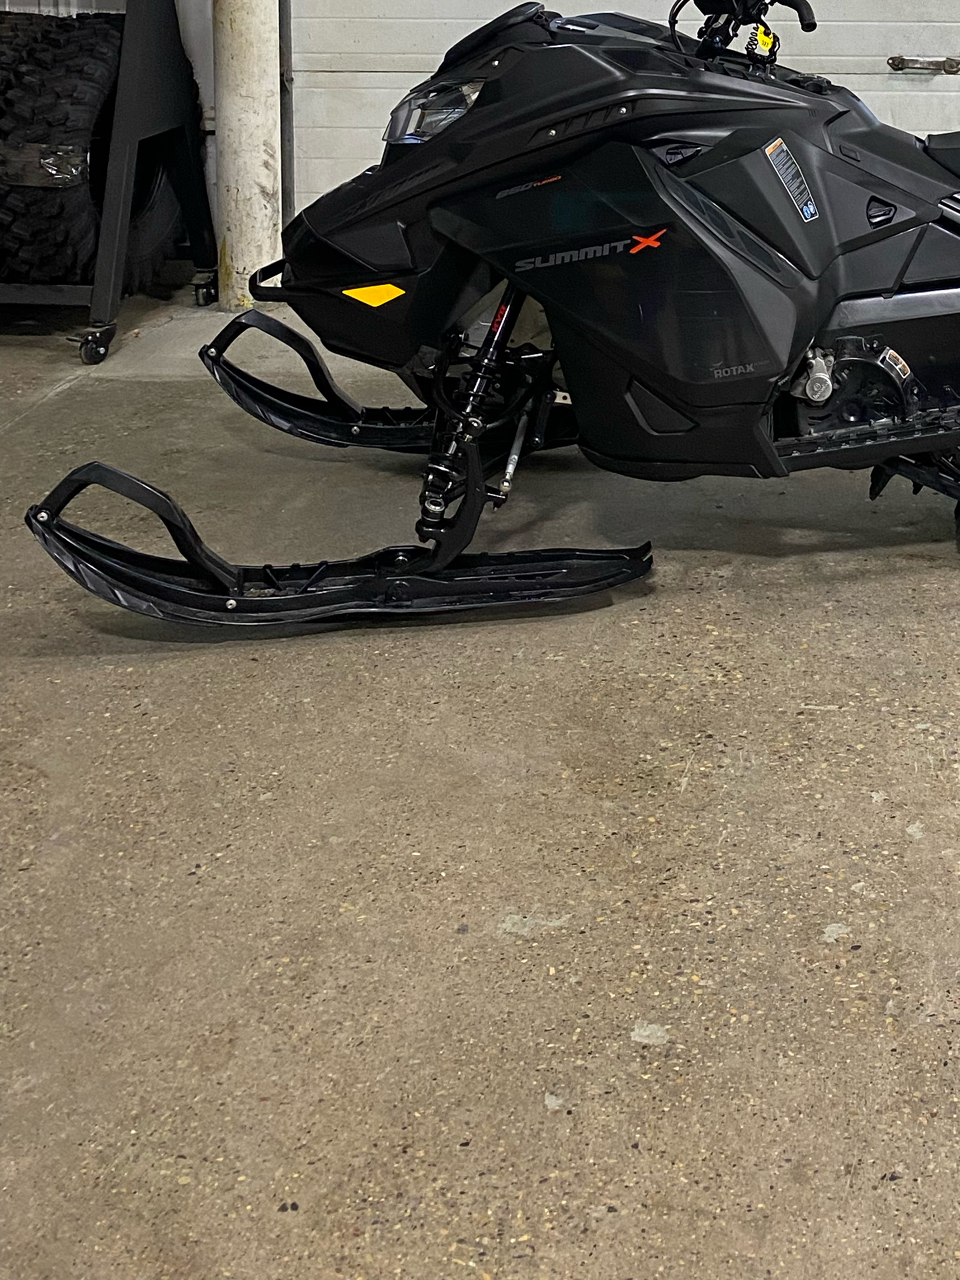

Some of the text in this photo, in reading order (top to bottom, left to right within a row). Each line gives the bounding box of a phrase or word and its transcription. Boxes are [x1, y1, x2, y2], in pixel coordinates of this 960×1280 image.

[514, 228, 668, 273] SUMMIT X
[713, 363, 755, 379] ROTAX
